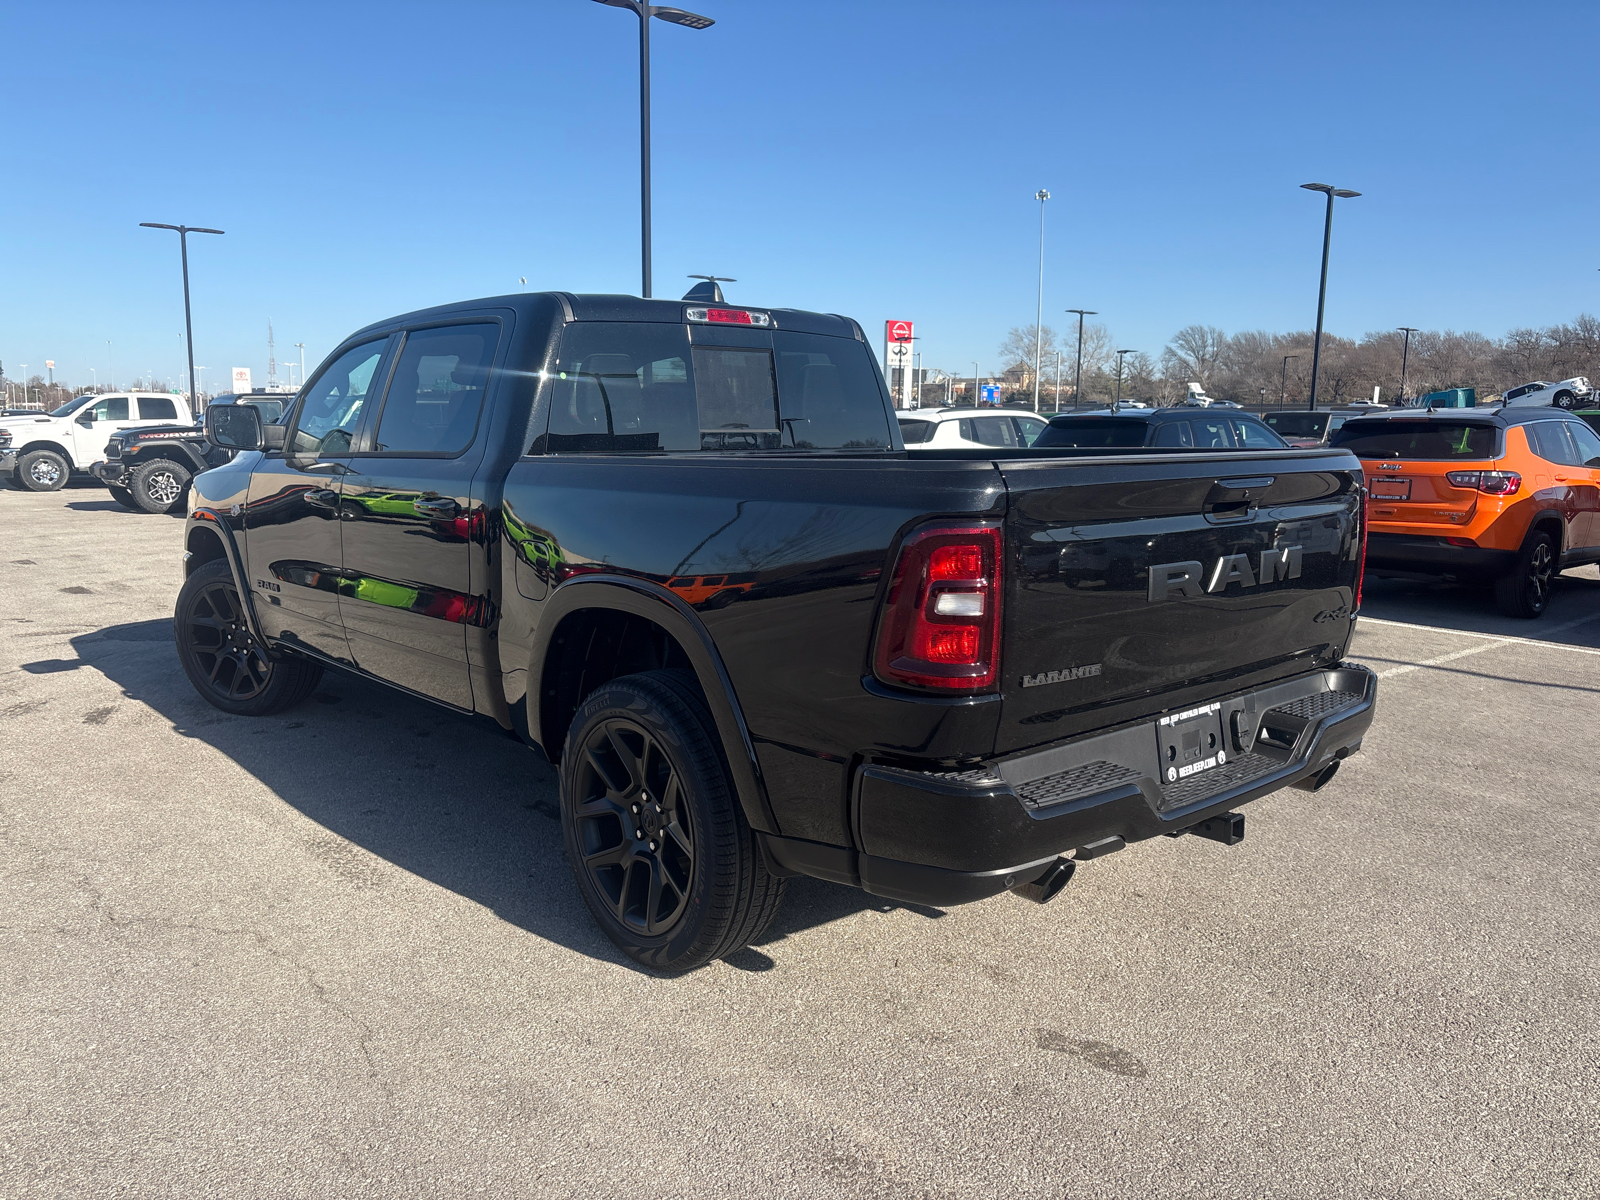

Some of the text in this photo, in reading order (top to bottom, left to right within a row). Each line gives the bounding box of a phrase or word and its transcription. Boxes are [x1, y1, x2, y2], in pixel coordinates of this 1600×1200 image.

[139, 431, 197, 439] MOJAVE
[1377, 463, 1402, 471] Jeep
[1148, 545, 1303, 602] RAM
[257, 579, 281, 592] RAM
[1020, 663, 1102, 688] LARAMIE
[585, 693, 612, 717] PIRELLI
[1178, 756, 1217, 778] REEDJEEP.COM
